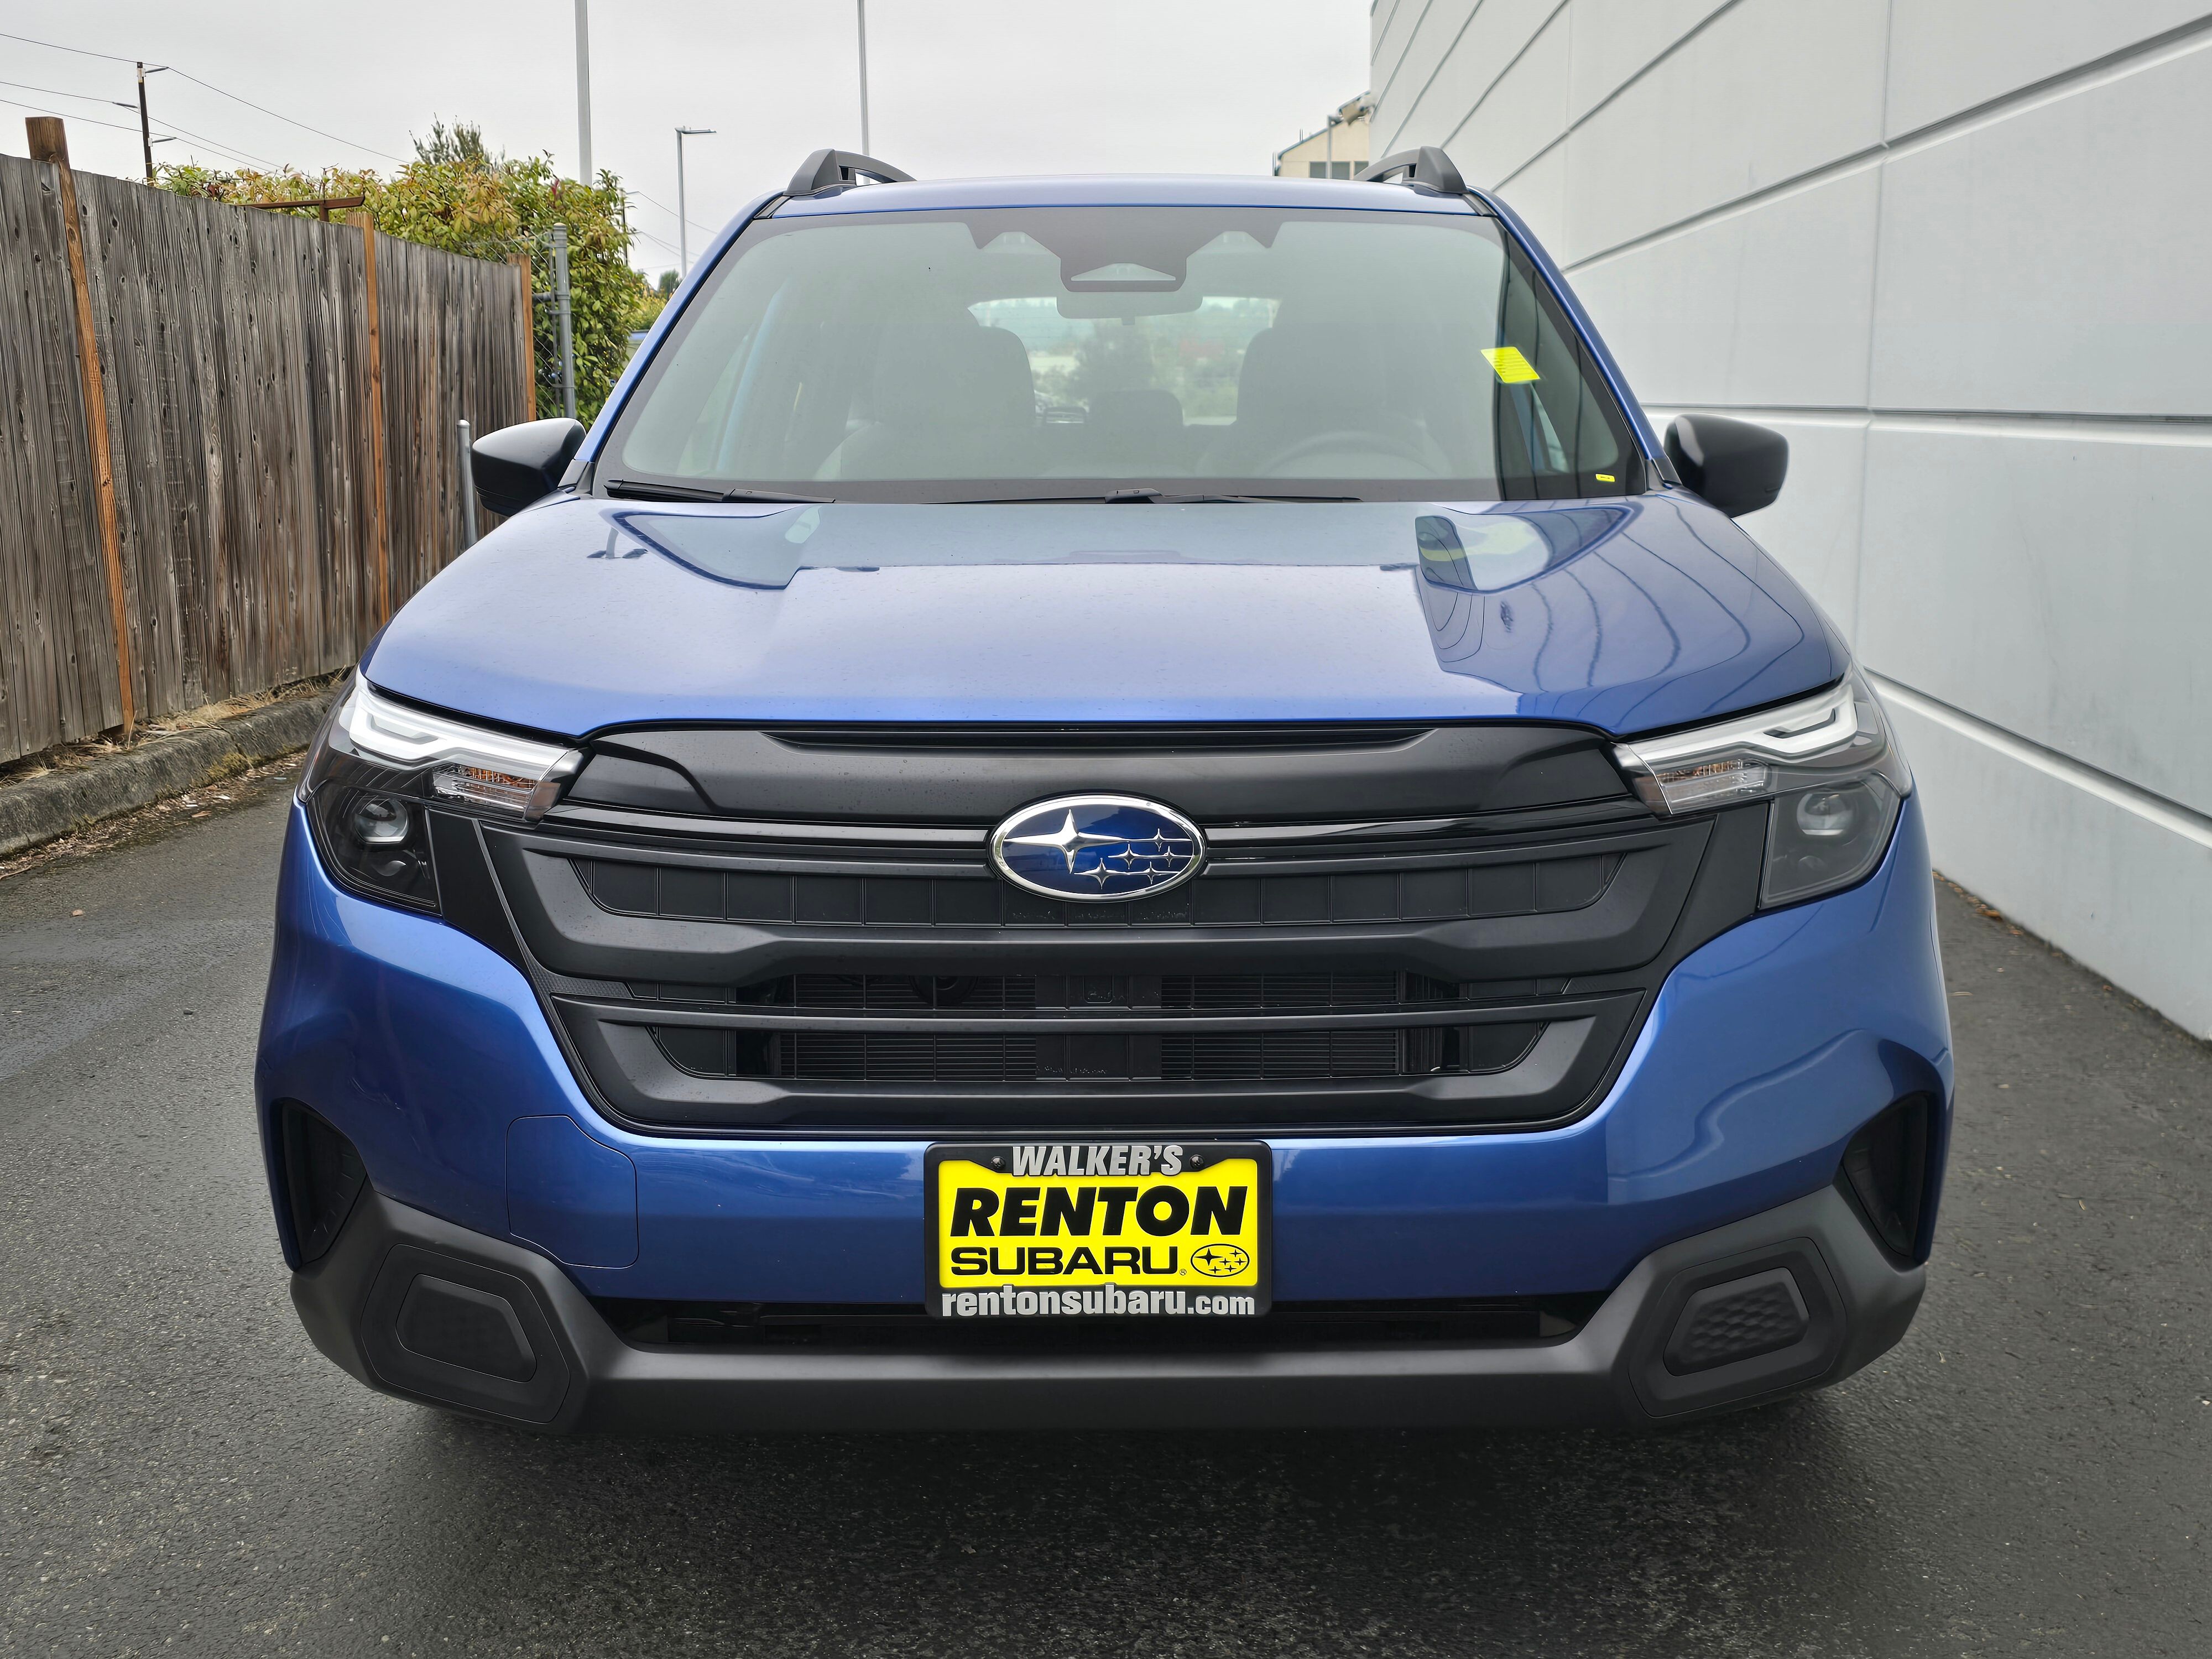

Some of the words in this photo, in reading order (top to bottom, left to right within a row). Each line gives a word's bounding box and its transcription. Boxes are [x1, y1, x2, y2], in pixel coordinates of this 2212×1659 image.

[1011, 1145, 1183, 1176] WALKER'S
[950, 1186, 1248, 1237] RENTON
[951, 1246, 1178, 1275] SUBARU
[942, 1283, 1255, 1317] rentonsubaru.com
